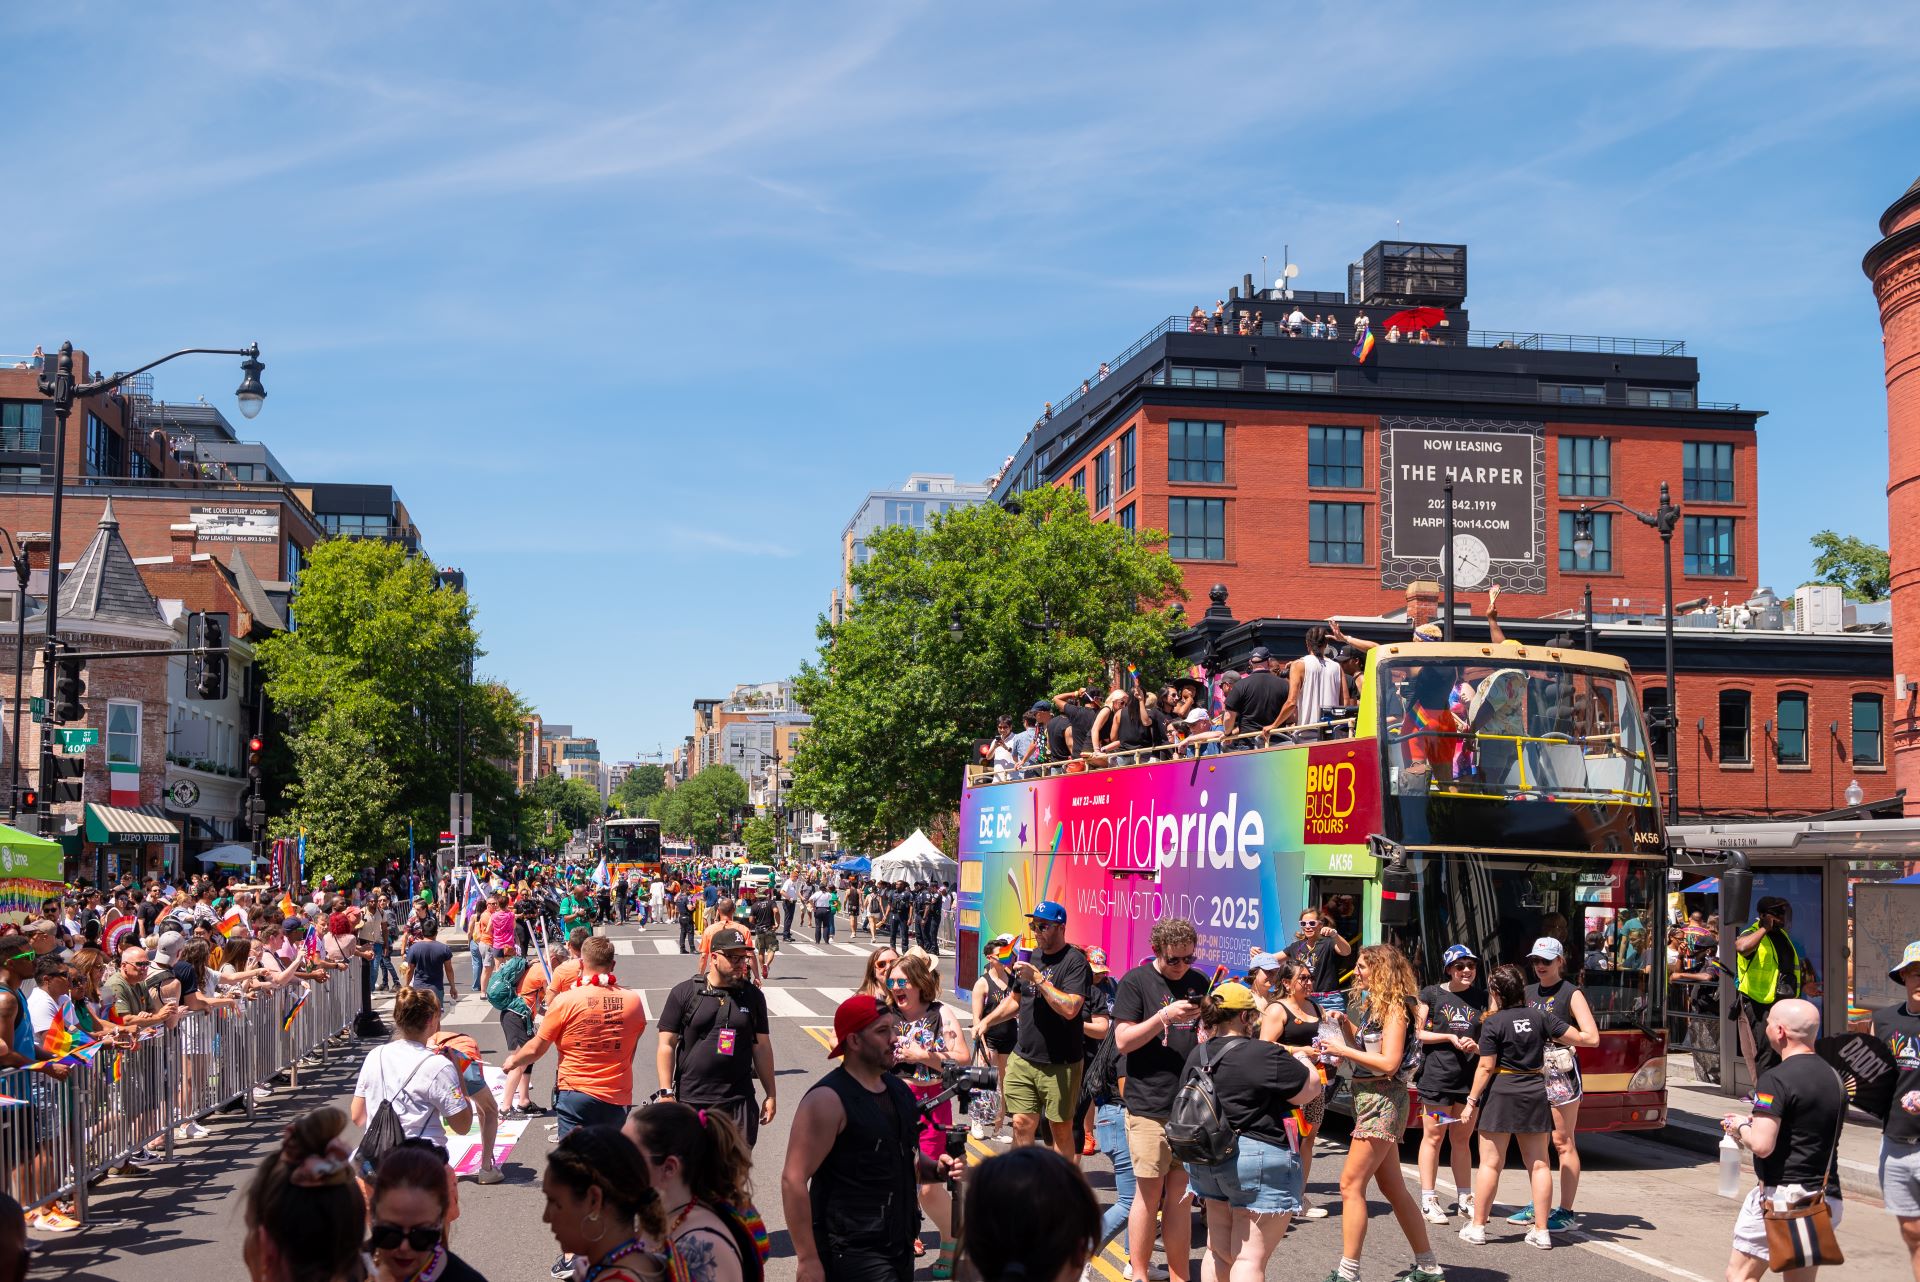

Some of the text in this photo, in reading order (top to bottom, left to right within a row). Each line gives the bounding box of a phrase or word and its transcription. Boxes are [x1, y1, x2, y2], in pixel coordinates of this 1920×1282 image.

[1424, 440, 1503, 452] NOW LEASING
[1401, 464, 1523, 484] THE HARPER
[1428, 499, 1497, 510] 202842.1919
[63, 730, 73, 743] T
[1307, 764, 1334, 793] BIG
[1072, 797, 1082, 806] MAY
[1106, 794, 1110, 804] 8
[1305, 793, 1332, 819] BUS
[979, 813, 994, 838] DC
[996, 812, 1012, 838] DC
[1311, 819, 1344, 834] TOURS
[120, 833, 170, 843] LUPO VERDE
[1633, 832, 1659, 844] AK56
[1717, 838, 1727, 847] 14th
[1748, 838, 1757, 846] NW
[1329, 853, 1353, 871] AK56
[1077, 888, 1260, 931] WASHINGTON DC 2025
[1219, 936, 1251, 951] DISCOVER
[603, 996, 624, 1004] EVENT
[1838, 1036, 1893, 1084] DADDY
